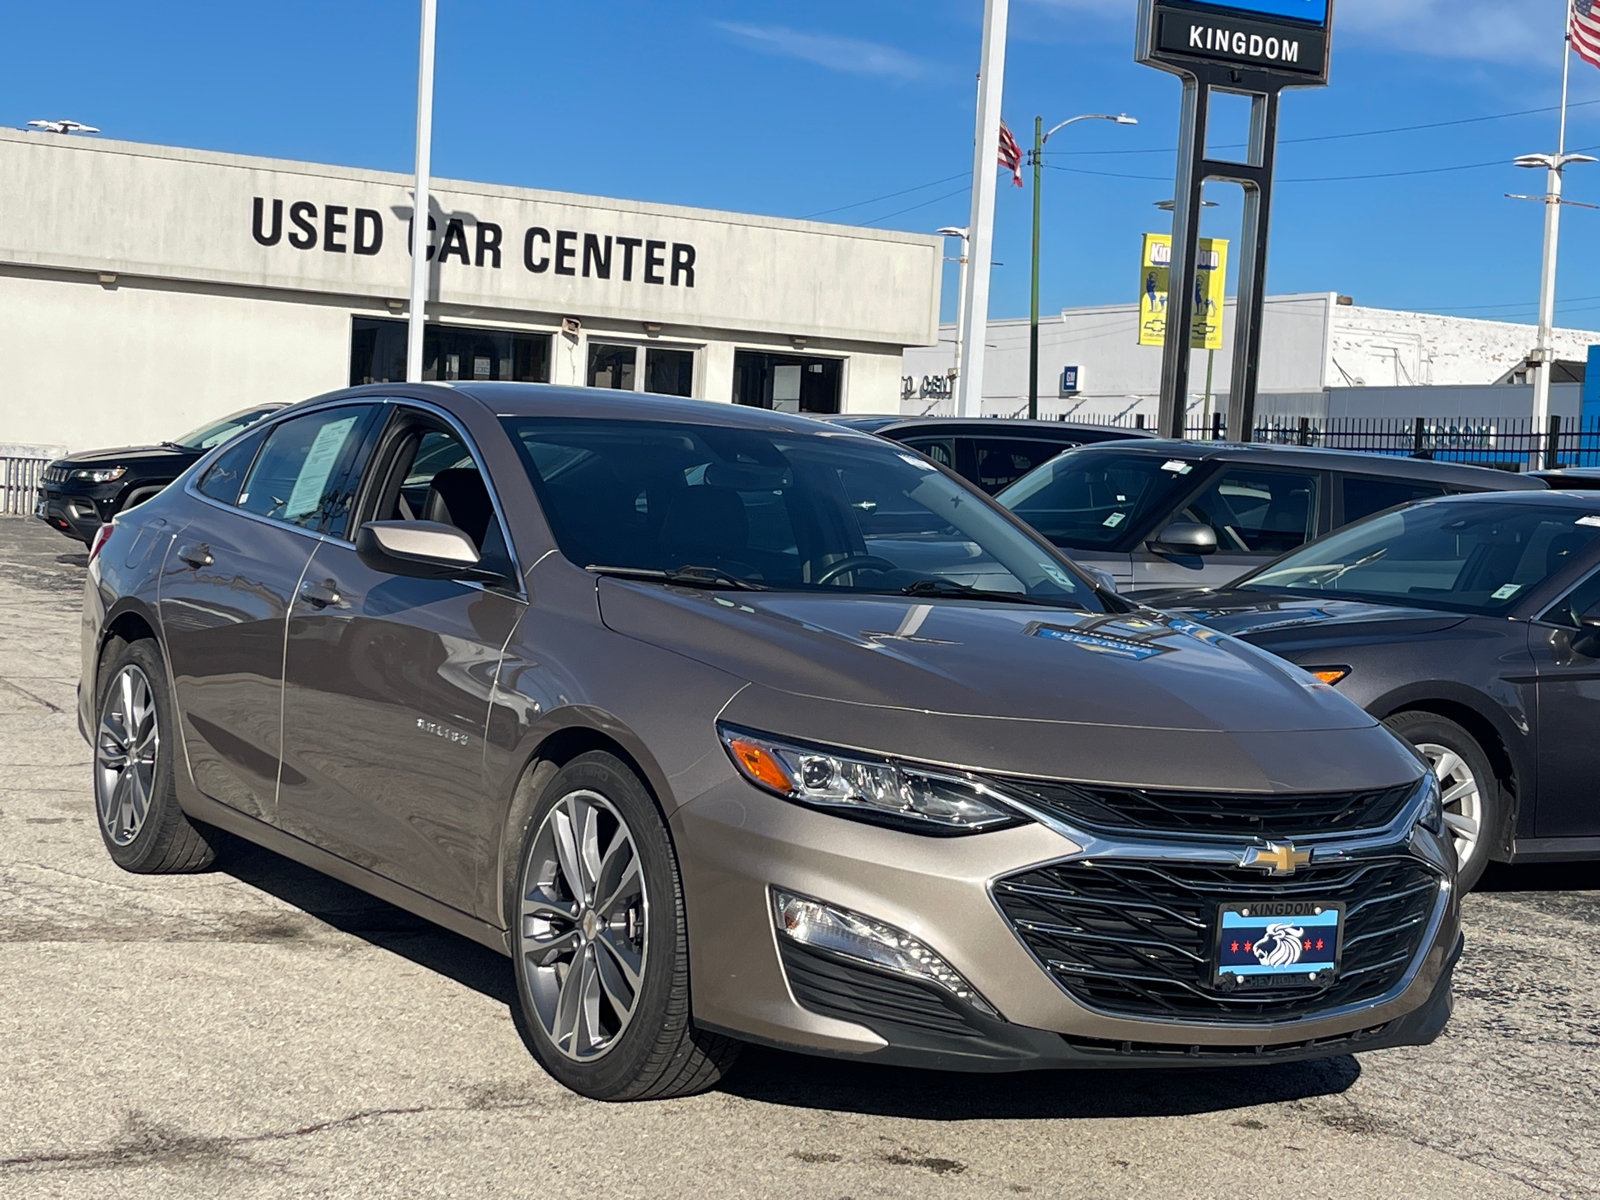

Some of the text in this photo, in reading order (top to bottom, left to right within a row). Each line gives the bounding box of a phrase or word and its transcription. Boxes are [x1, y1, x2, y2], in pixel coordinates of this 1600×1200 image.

[1189, 25, 1298, 62] KINGDOM
[252, 196, 696, 288] USED CAR CENTER
[1250, 902, 1315, 915] KINGDOM
